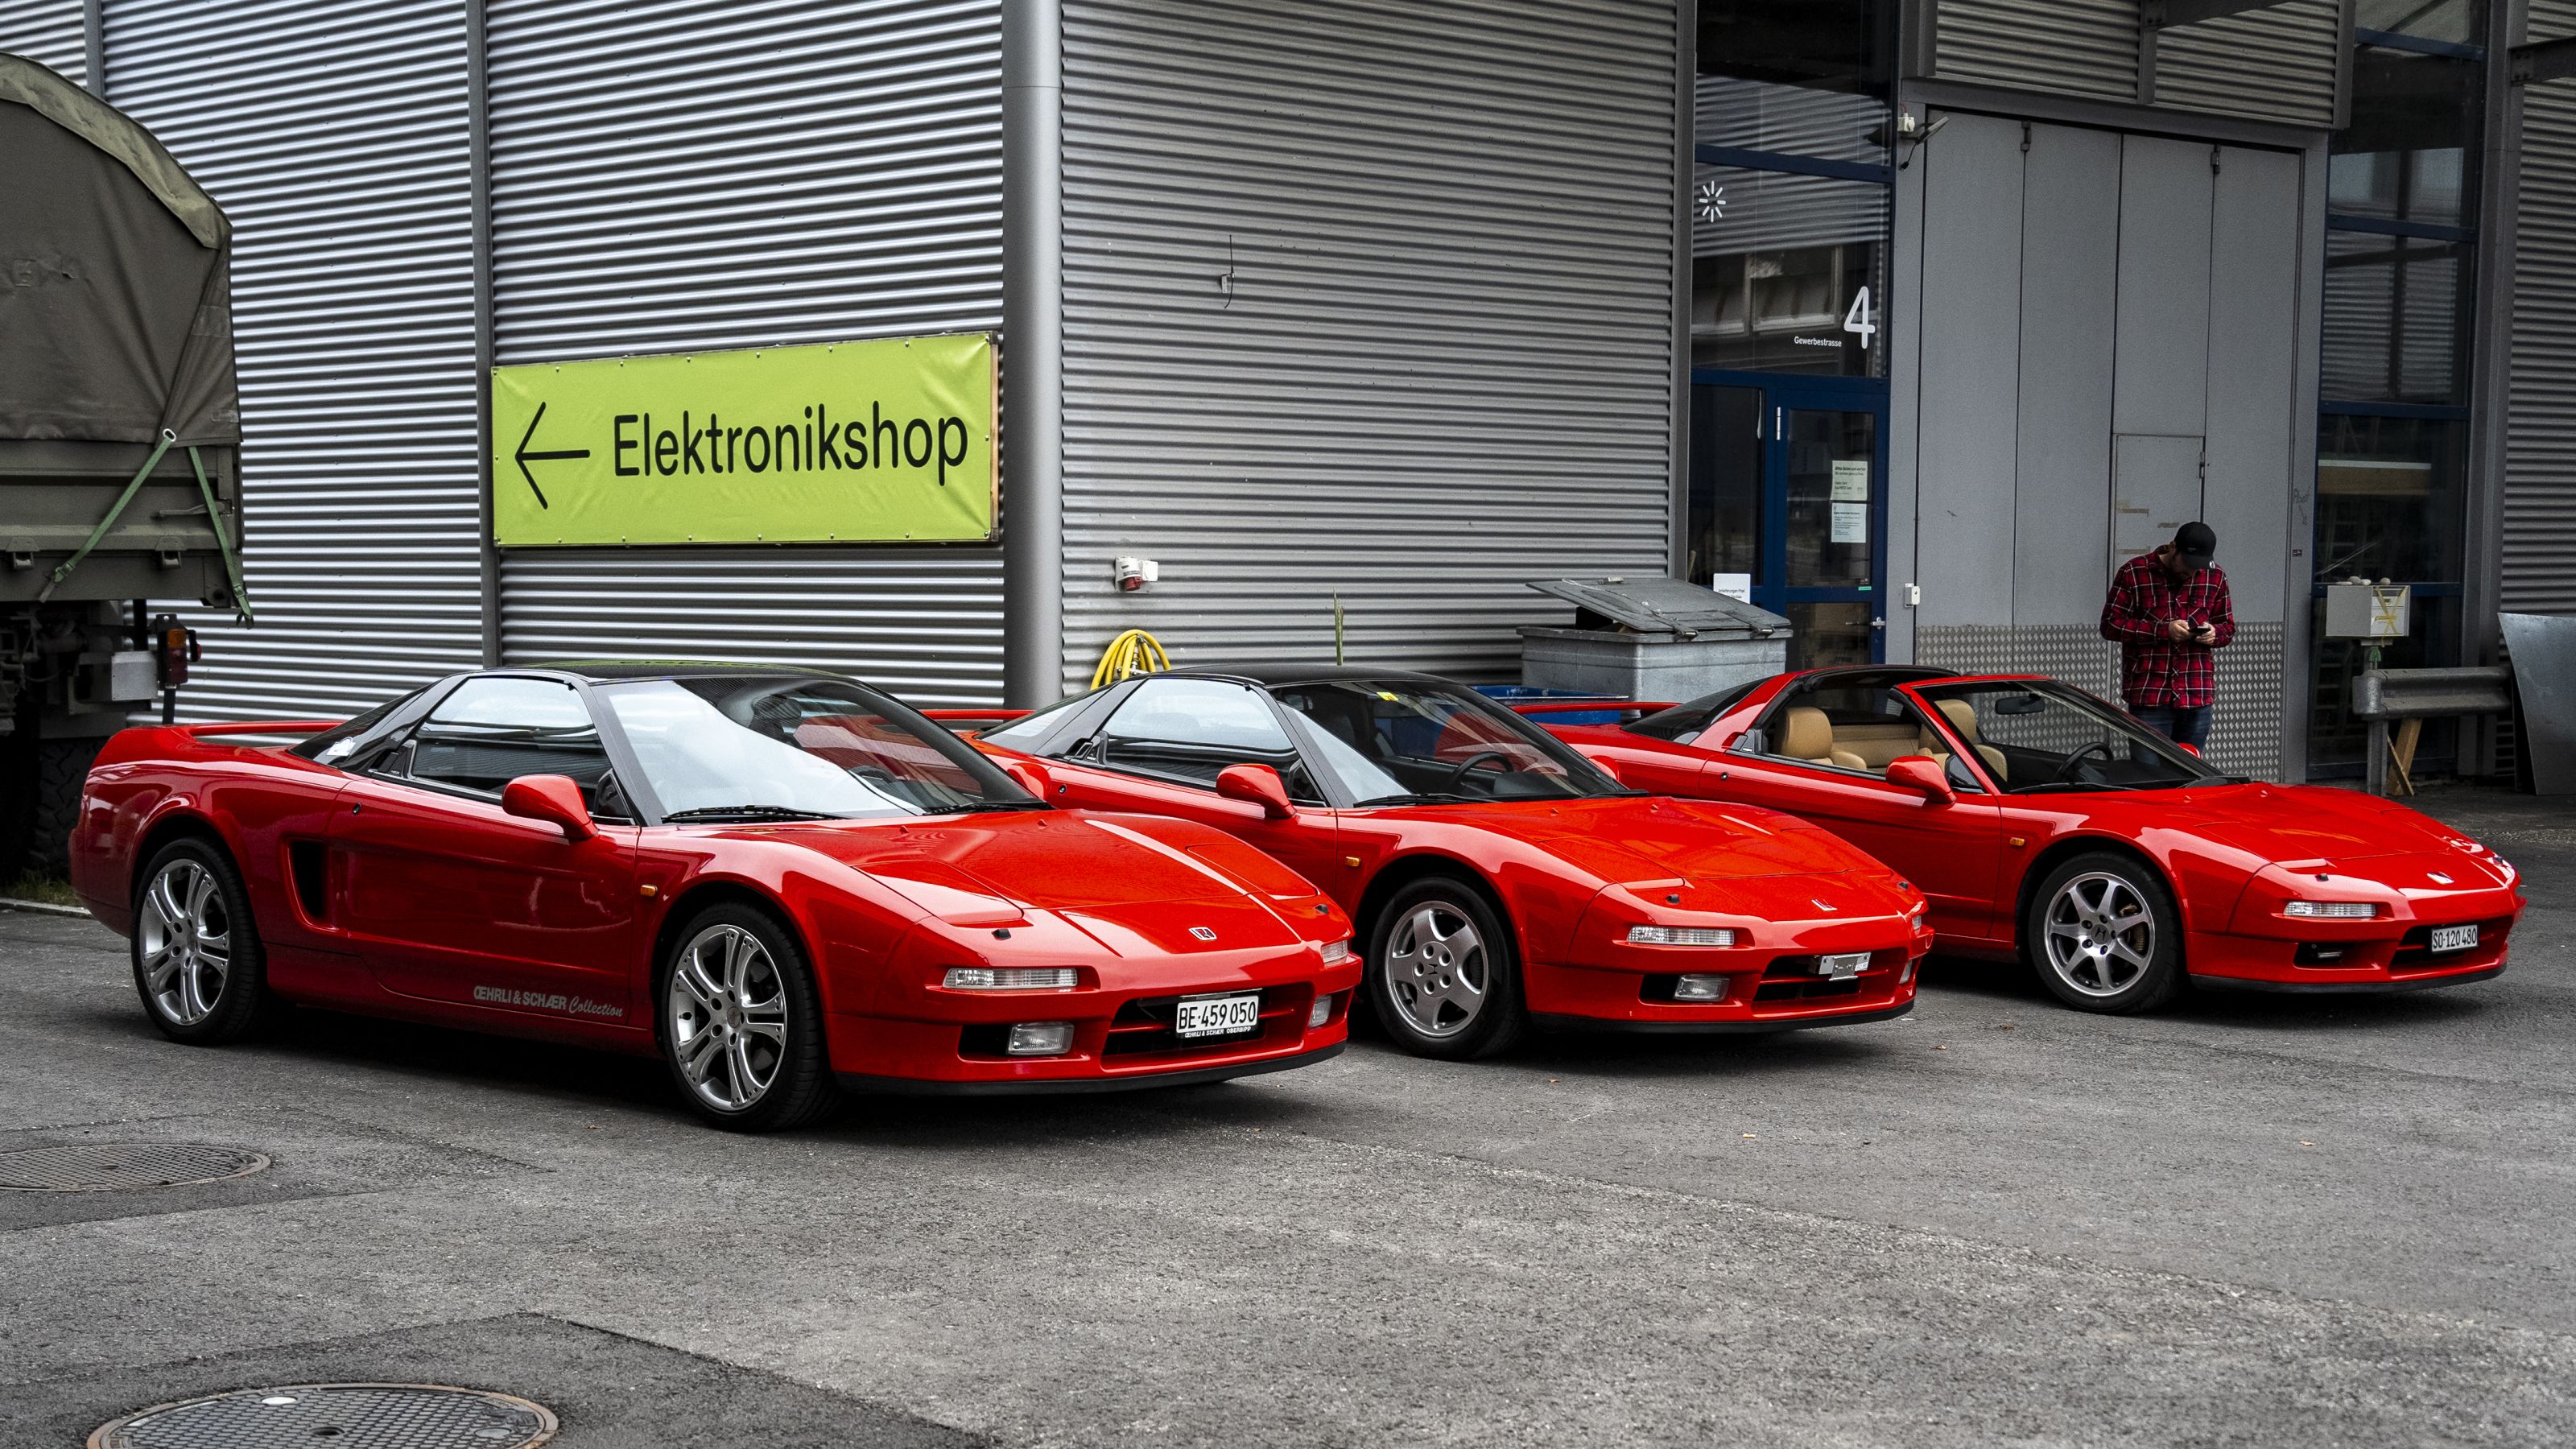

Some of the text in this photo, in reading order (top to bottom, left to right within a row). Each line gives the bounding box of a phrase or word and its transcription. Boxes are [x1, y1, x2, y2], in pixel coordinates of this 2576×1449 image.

[1843, 286, 1876, 349] 4
[1794, 336, 1842, 347] Gewerbestrasse
[614, 400, 968, 486] Elektronikshop
[2462, 927, 2477, 945] 480
[513, 990, 522, 1005] &
[568, 995, 624, 1018] Collection
[1229, 1001, 1256, 1025] 050
